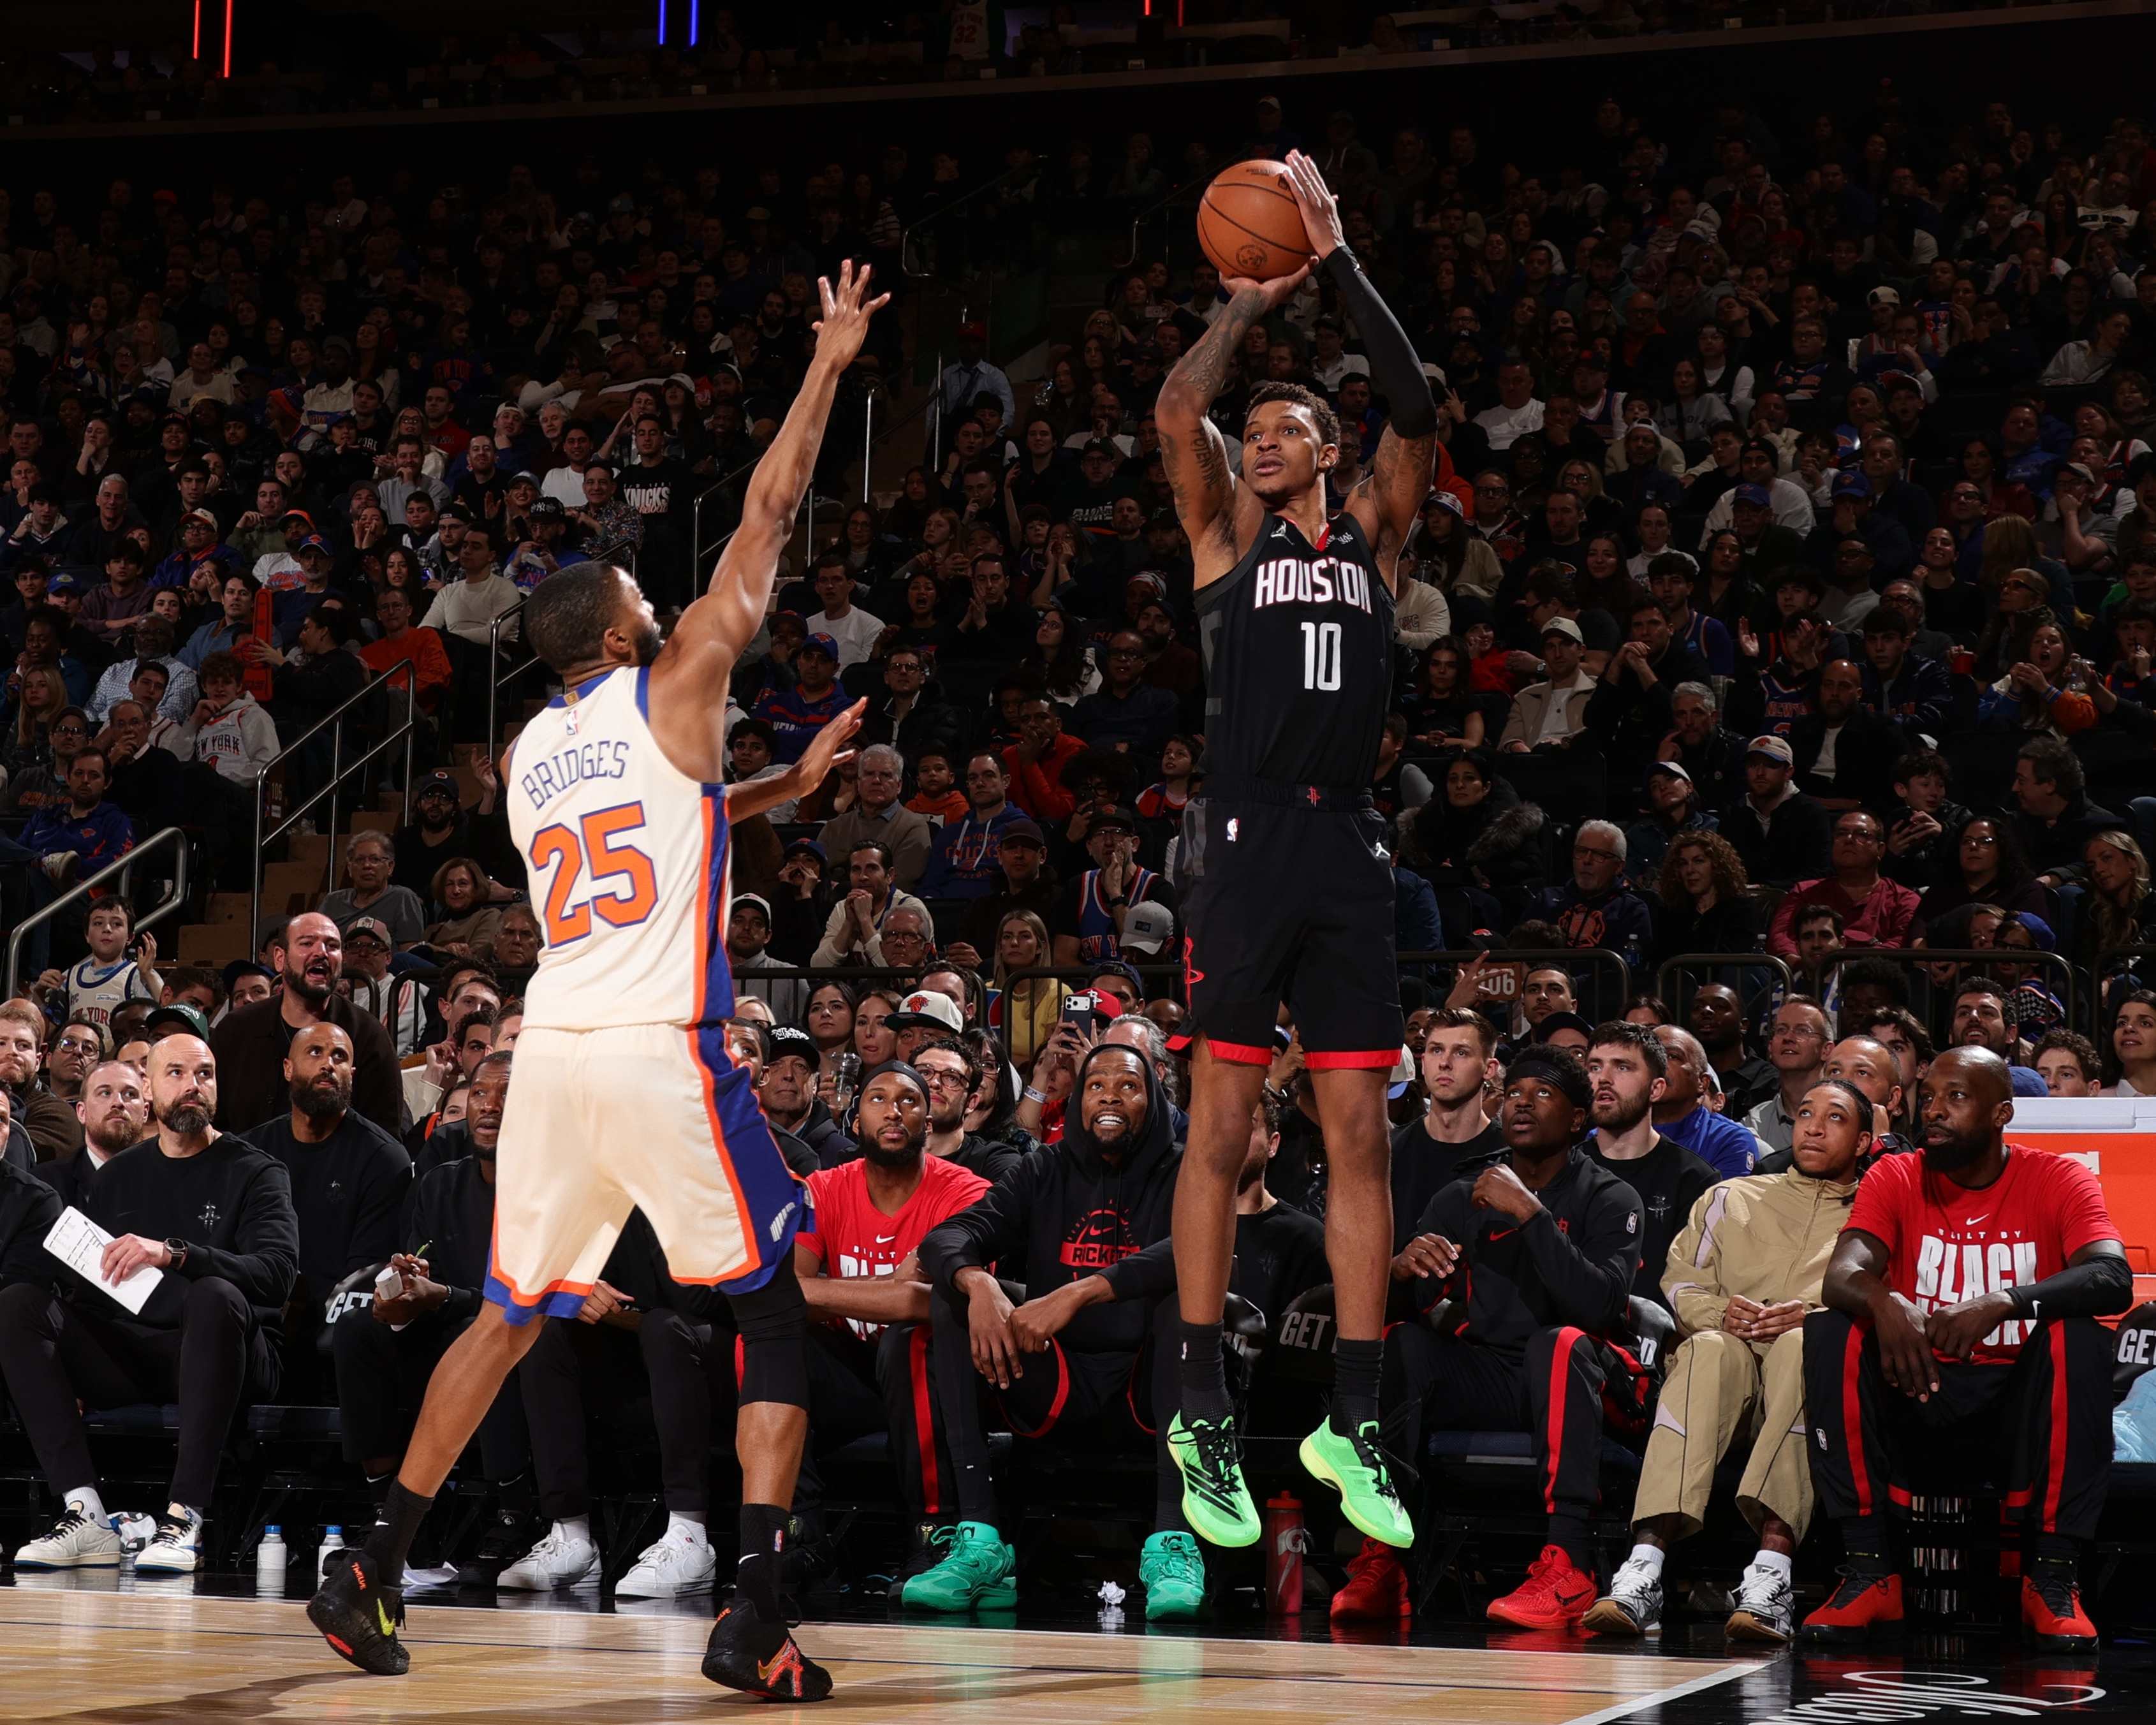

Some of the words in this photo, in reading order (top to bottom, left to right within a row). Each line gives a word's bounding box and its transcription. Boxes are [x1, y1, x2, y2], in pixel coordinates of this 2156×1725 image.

[953, 25, 978, 43] 32
[623, 487, 671, 509] KNICKS
[1254, 557, 1372, 615] HOUSTON
[1300, 622, 1342, 691] 10
[1765, 701, 1793, 717] NEW
[212, 734, 241, 756] YORK
[520, 739, 630, 811] BRIDGES
[271, 782, 283, 802] 106
[531, 801, 659, 950] 25
[86, 1006, 110, 1027] YOR
[165, 1004, 201, 1020] HAMPIONS
[2000, 1230, 2022, 1240] BY
[1915, 1233, 2039, 1305] BLACK
[325, 1291, 376, 1325] GET
[1279, 1311, 1333, 1352] GET
[2116, 1328, 2156, 1366] GE
